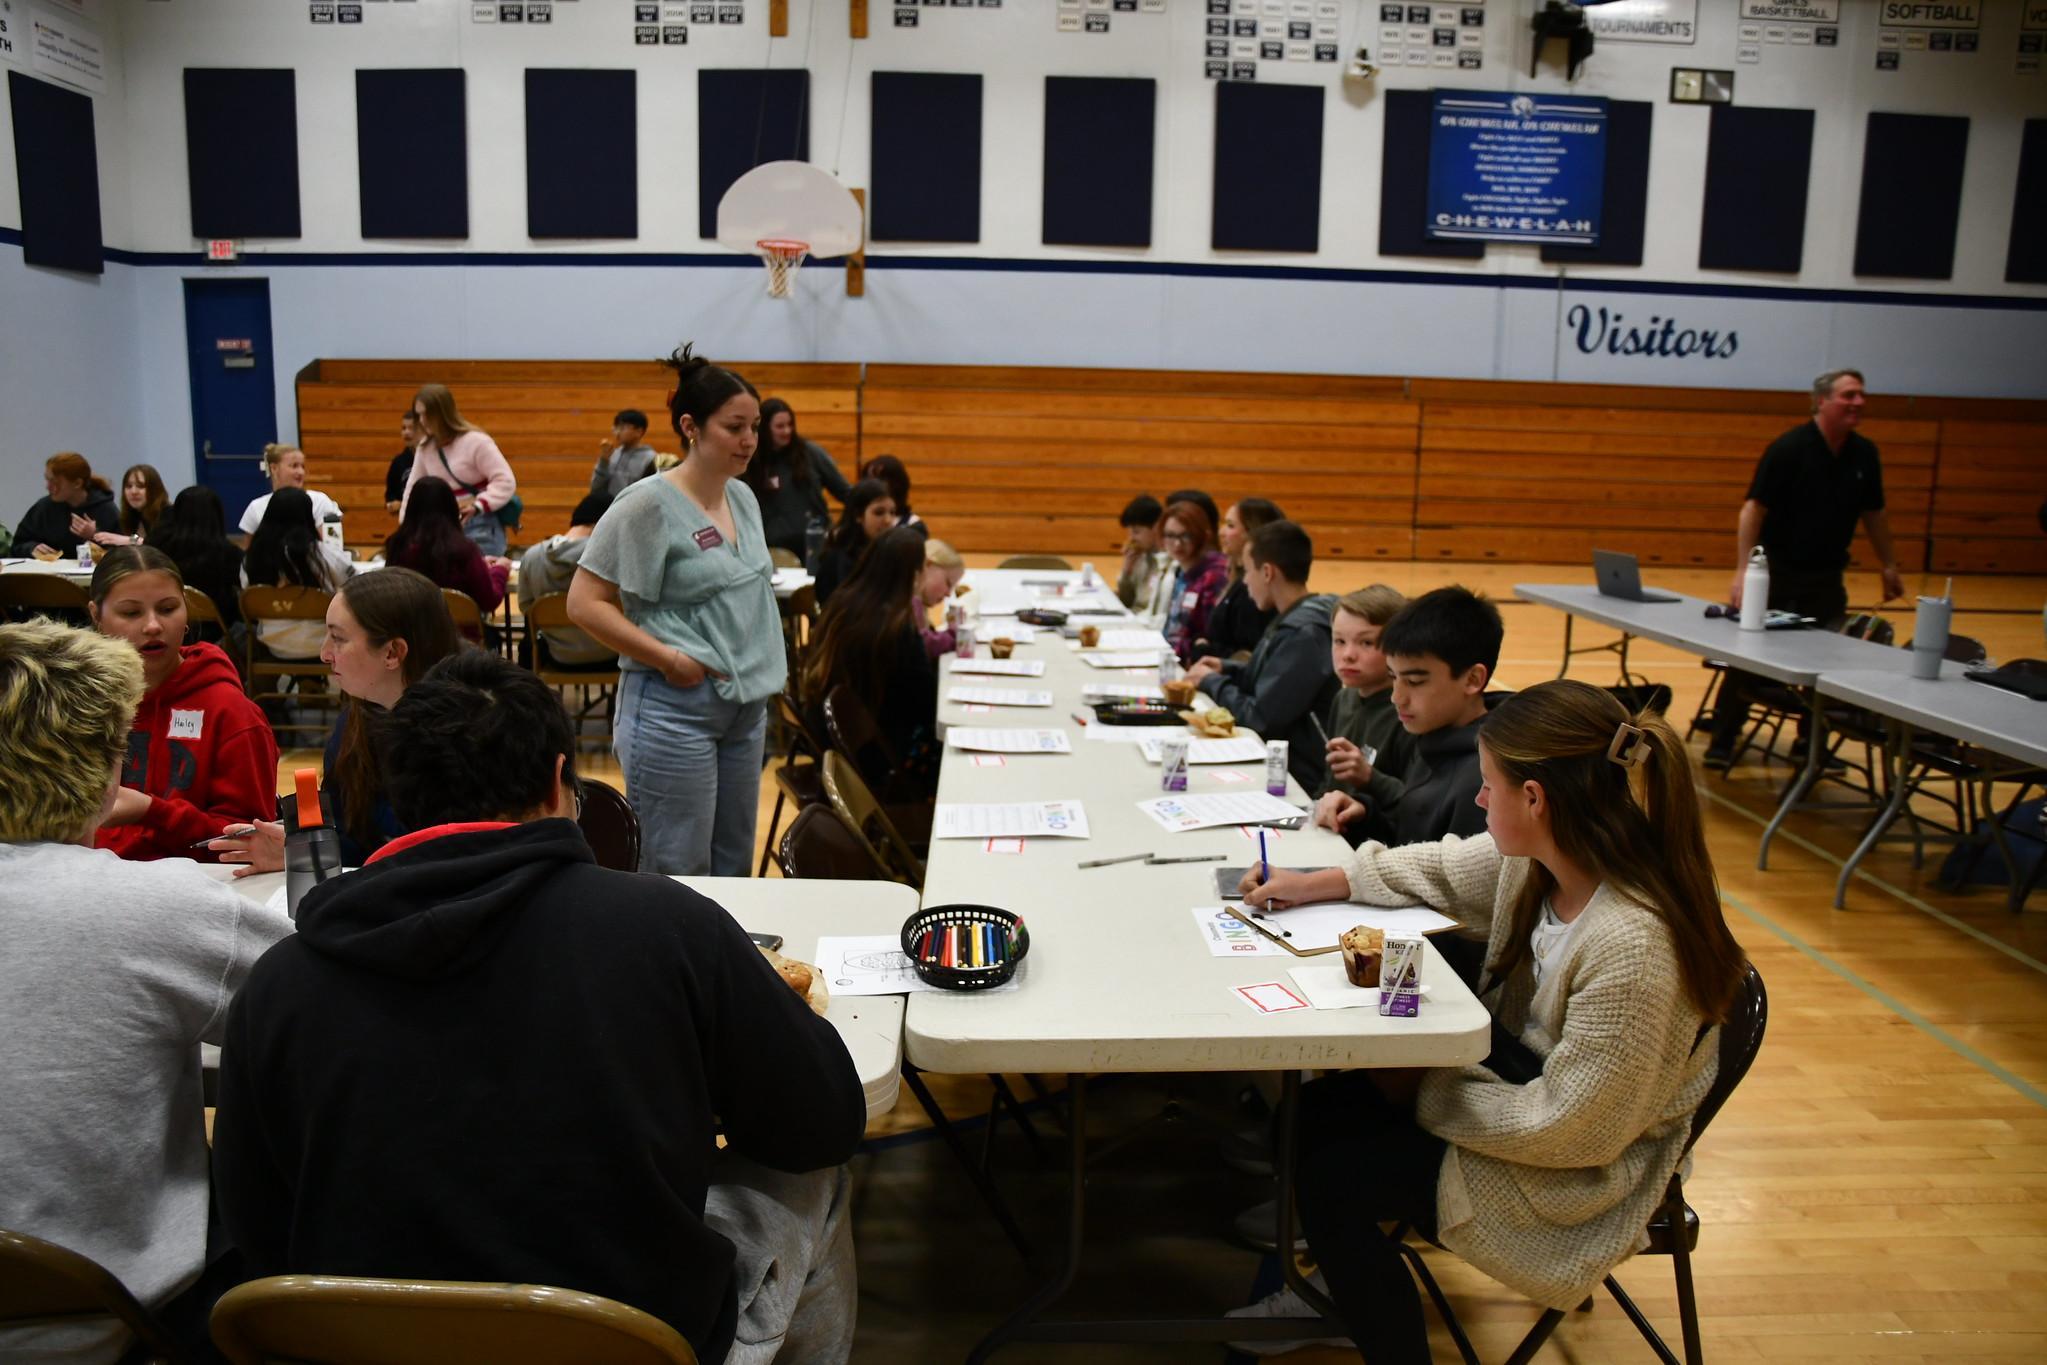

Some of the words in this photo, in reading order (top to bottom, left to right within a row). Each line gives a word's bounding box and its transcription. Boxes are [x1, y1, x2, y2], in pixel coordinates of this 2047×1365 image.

[1887, 3, 1975, 21] SOFTBALL
[211, 240, 232, 257] EXIT
[1568, 304, 1739, 359] Visitors
